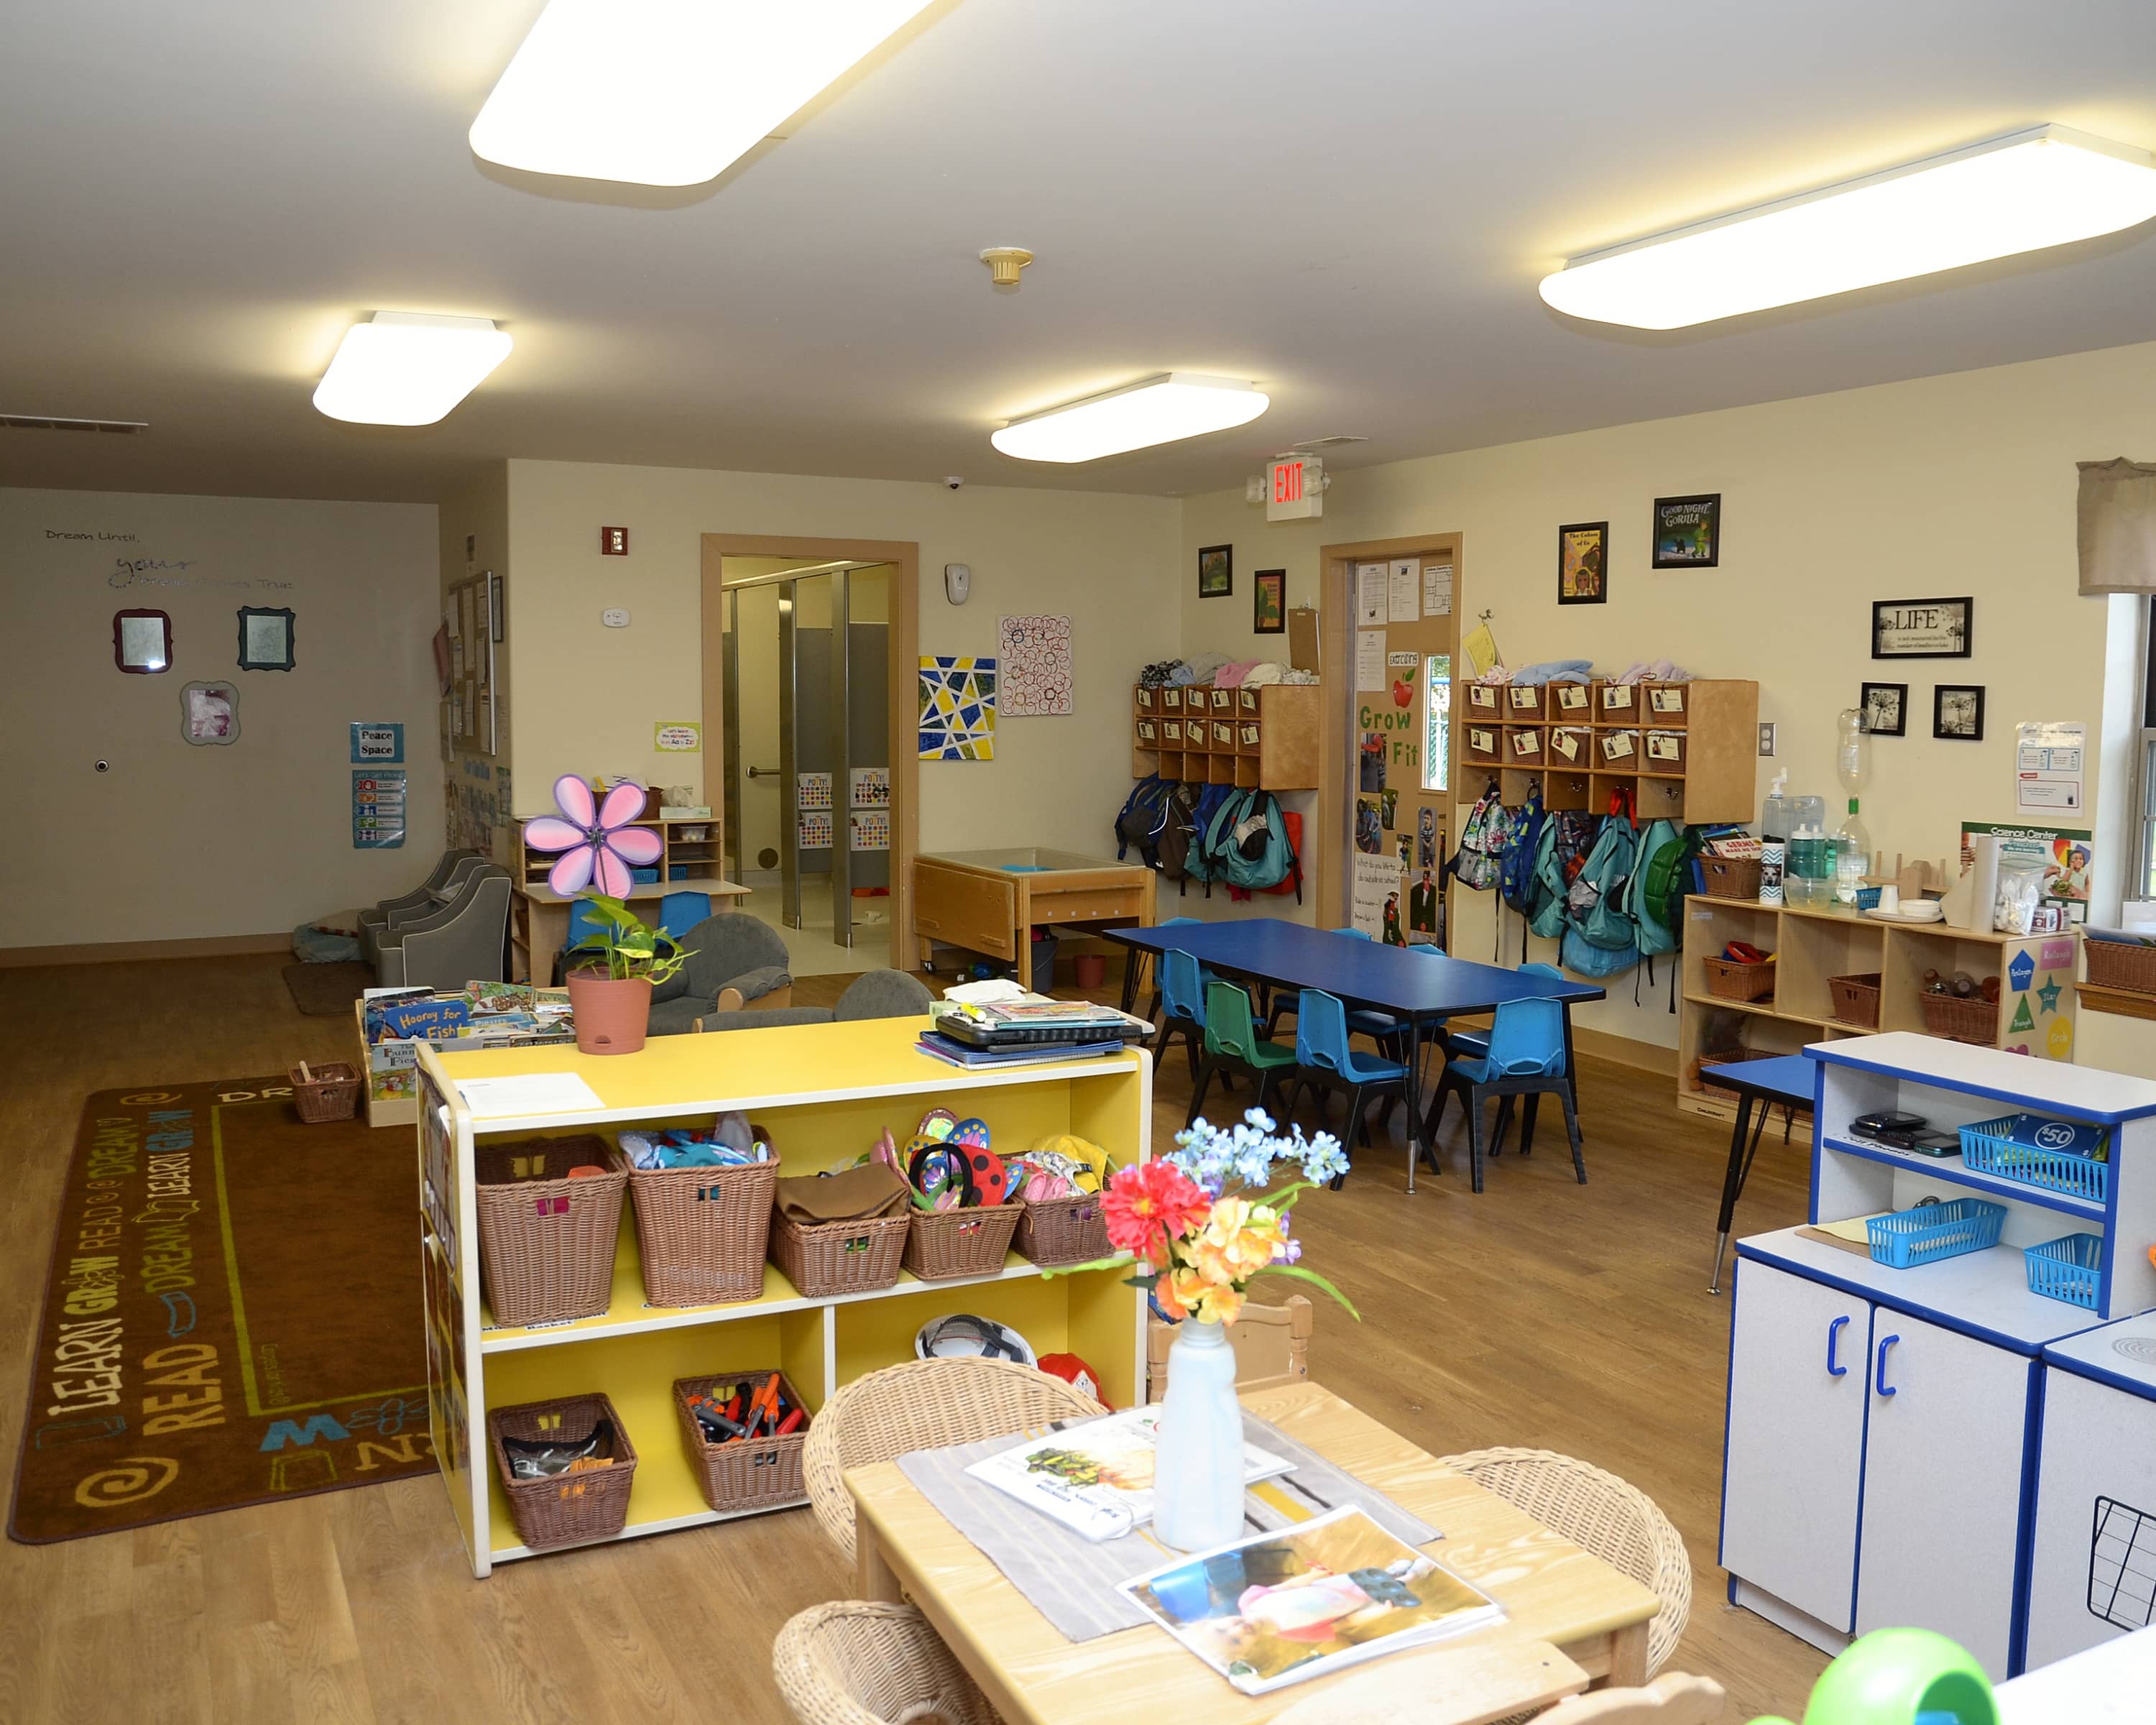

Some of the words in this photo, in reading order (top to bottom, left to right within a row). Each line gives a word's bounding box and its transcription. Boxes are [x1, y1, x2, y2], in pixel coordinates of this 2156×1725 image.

[1275, 462, 1303, 503] EXIT
[1661, 505, 1682, 518] GOOD
[1666, 513, 1699, 527] GORILLA
[46, 530, 93, 540] Dream
[1895, 609, 1939, 630] LIFE
[1360, 706, 1411, 730] Grow
[361, 731, 392, 740] Peace
[361, 745, 392, 755] Space
[1393, 742, 1417, 766] Fit
[1991, 827, 2025, 840] Science
[2027, 829, 2058, 841] Center
[400, 1011, 438, 1030] Hooray
[443, 1008, 462, 1020] for
[384, 1048, 415, 1057] Bunn
[2042, 1127, 2071, 1144] $50
[147, 1152, 192, 1199] LEARN
[78, 1206, 123, 1251] READ
[139, 1223, 196, 1294] DREAM
[47, 1318, 124, 1416] LEARN
[142, 1343, 226, 1436] READ
